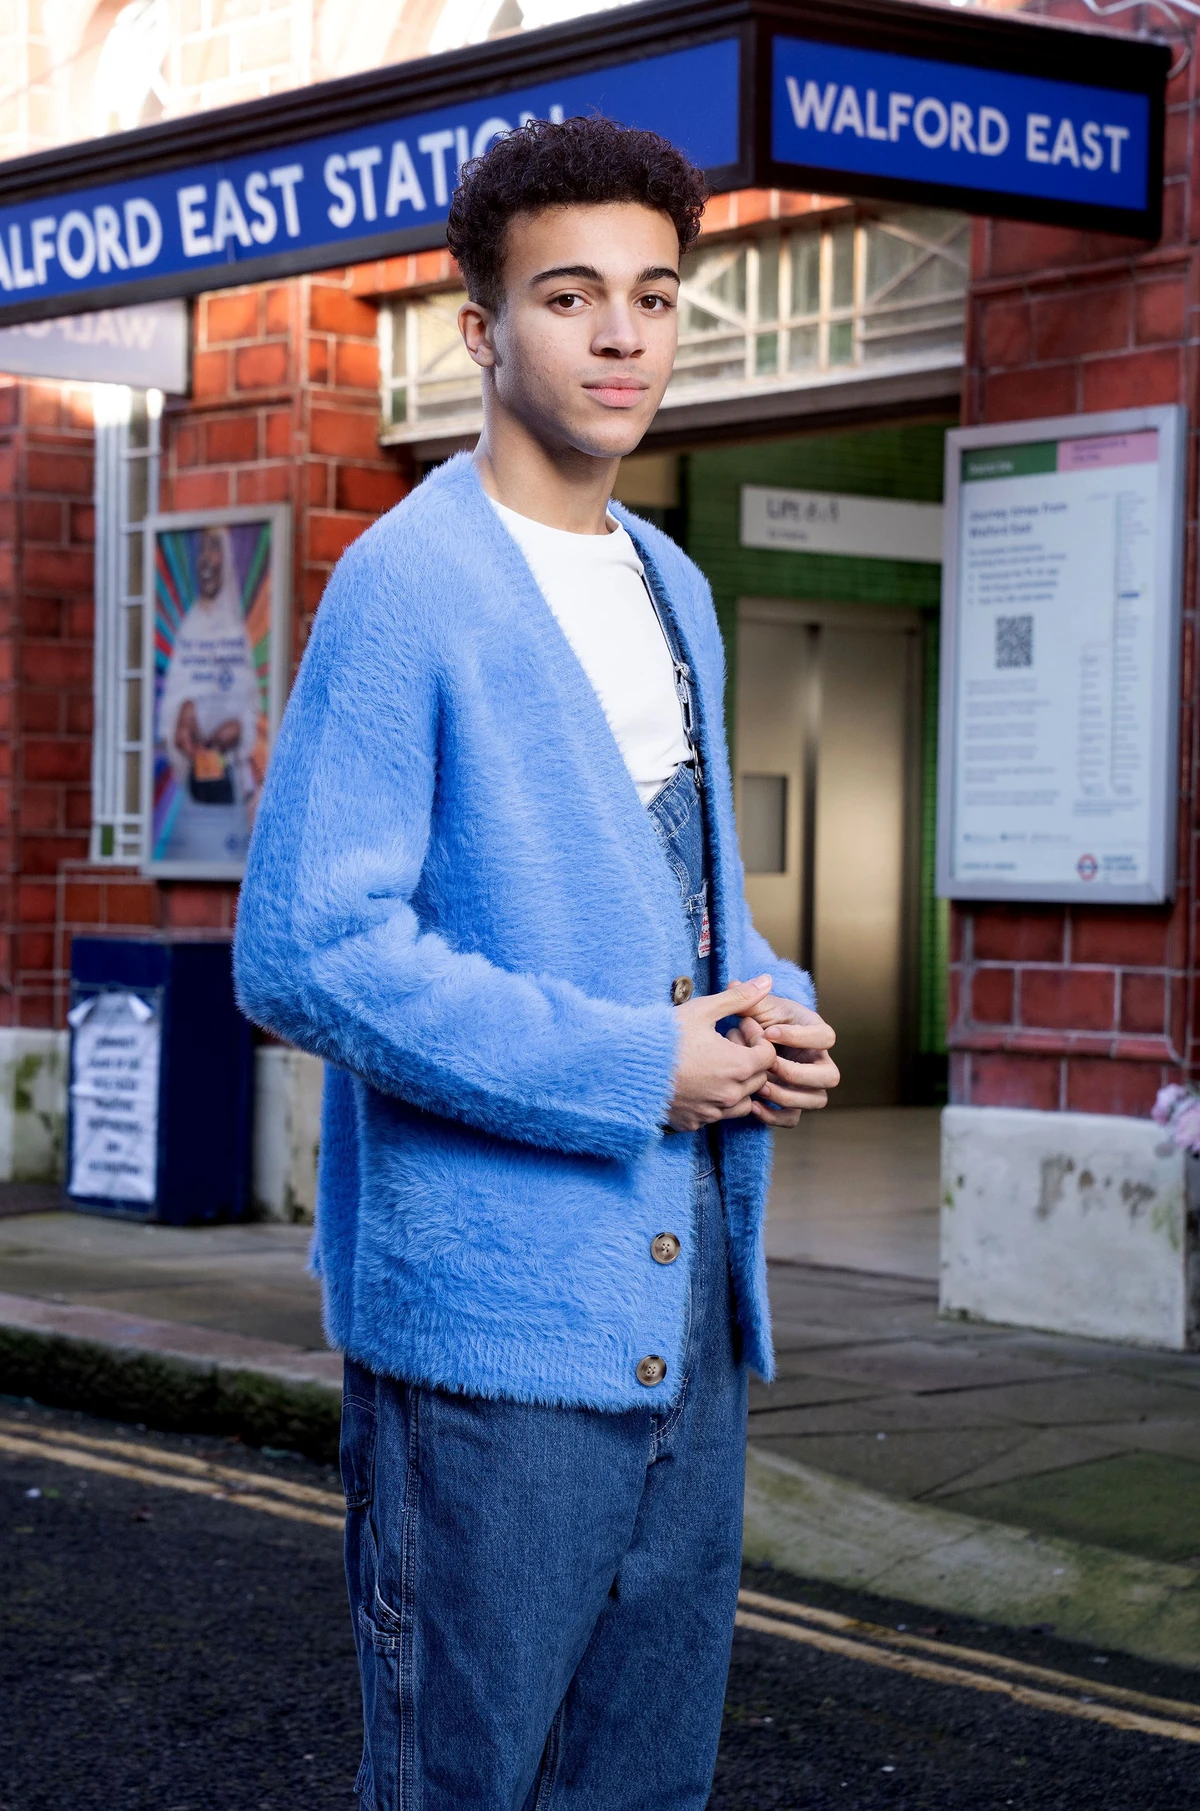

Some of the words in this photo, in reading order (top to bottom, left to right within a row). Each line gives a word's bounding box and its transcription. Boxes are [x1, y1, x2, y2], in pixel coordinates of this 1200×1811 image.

[177, 163, 304, 257] EAST
[323, 104, 565, 229] STATI
[785, 76, 1010, 157] WALFORD
[1026, 113, 1130, 173] EAST
